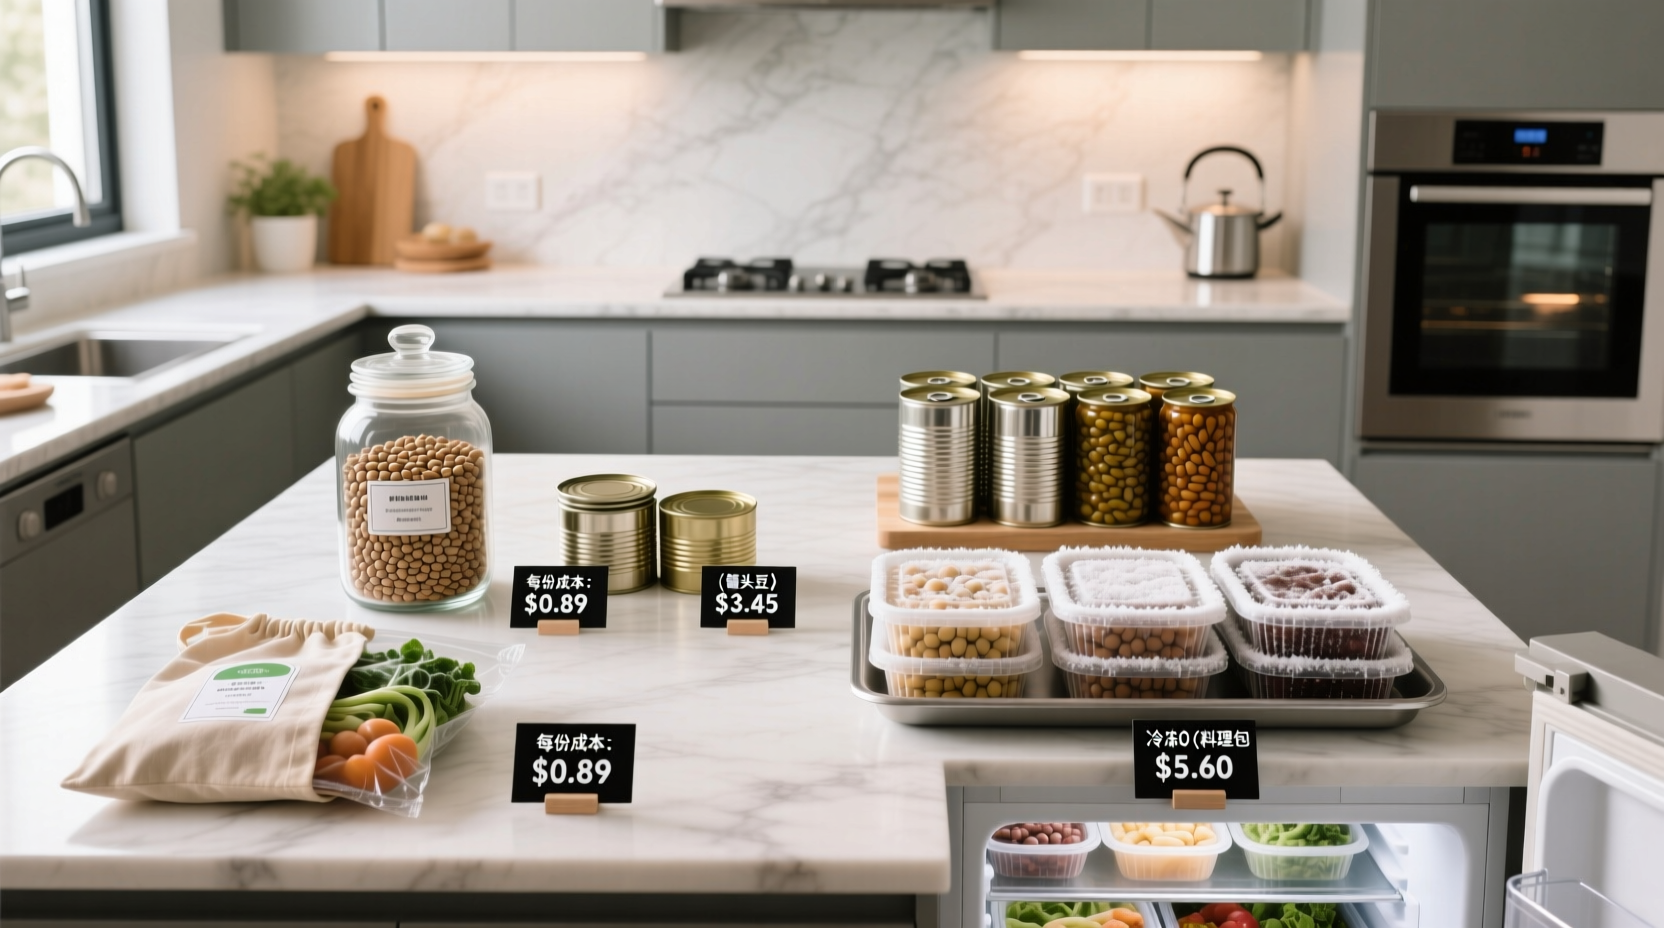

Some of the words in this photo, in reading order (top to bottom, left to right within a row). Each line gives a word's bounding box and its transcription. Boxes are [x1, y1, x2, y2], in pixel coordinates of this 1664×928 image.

[524, 592, 588, 616] $0.89
[715, 592, 778, 615] $3.45
[532, 756, 612, 787] $0.89
[1155, 752, 1233, 783] $5.60
